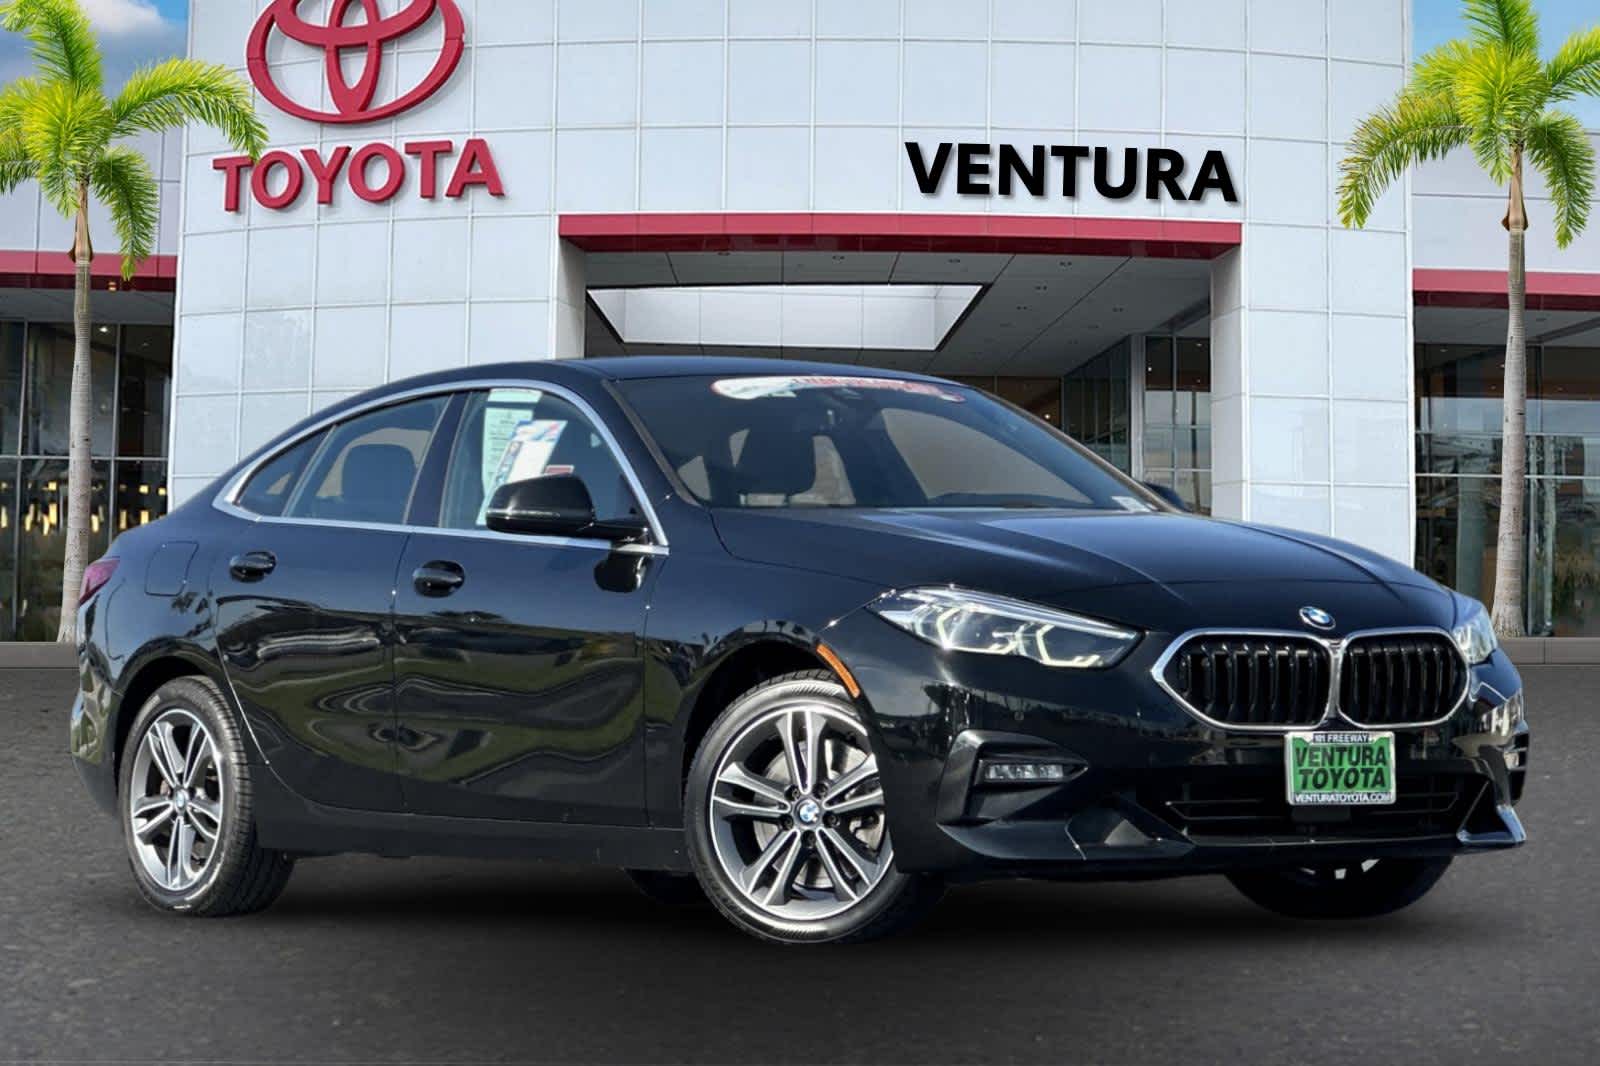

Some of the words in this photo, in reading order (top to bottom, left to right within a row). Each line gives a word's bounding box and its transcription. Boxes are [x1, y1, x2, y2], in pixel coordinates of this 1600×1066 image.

[212, 138, 505, 212] TOYOTA
[904, 141, 1239, 203] VENTURA
[1327, 734, 1369, 742] FREEWAY
[1295, 746, 1387, 767] VENTURA
[1299, 767, 1387, 790] TOYOTA
[1294, 792, 1392, 803] VENTURATOYOTA.COM
